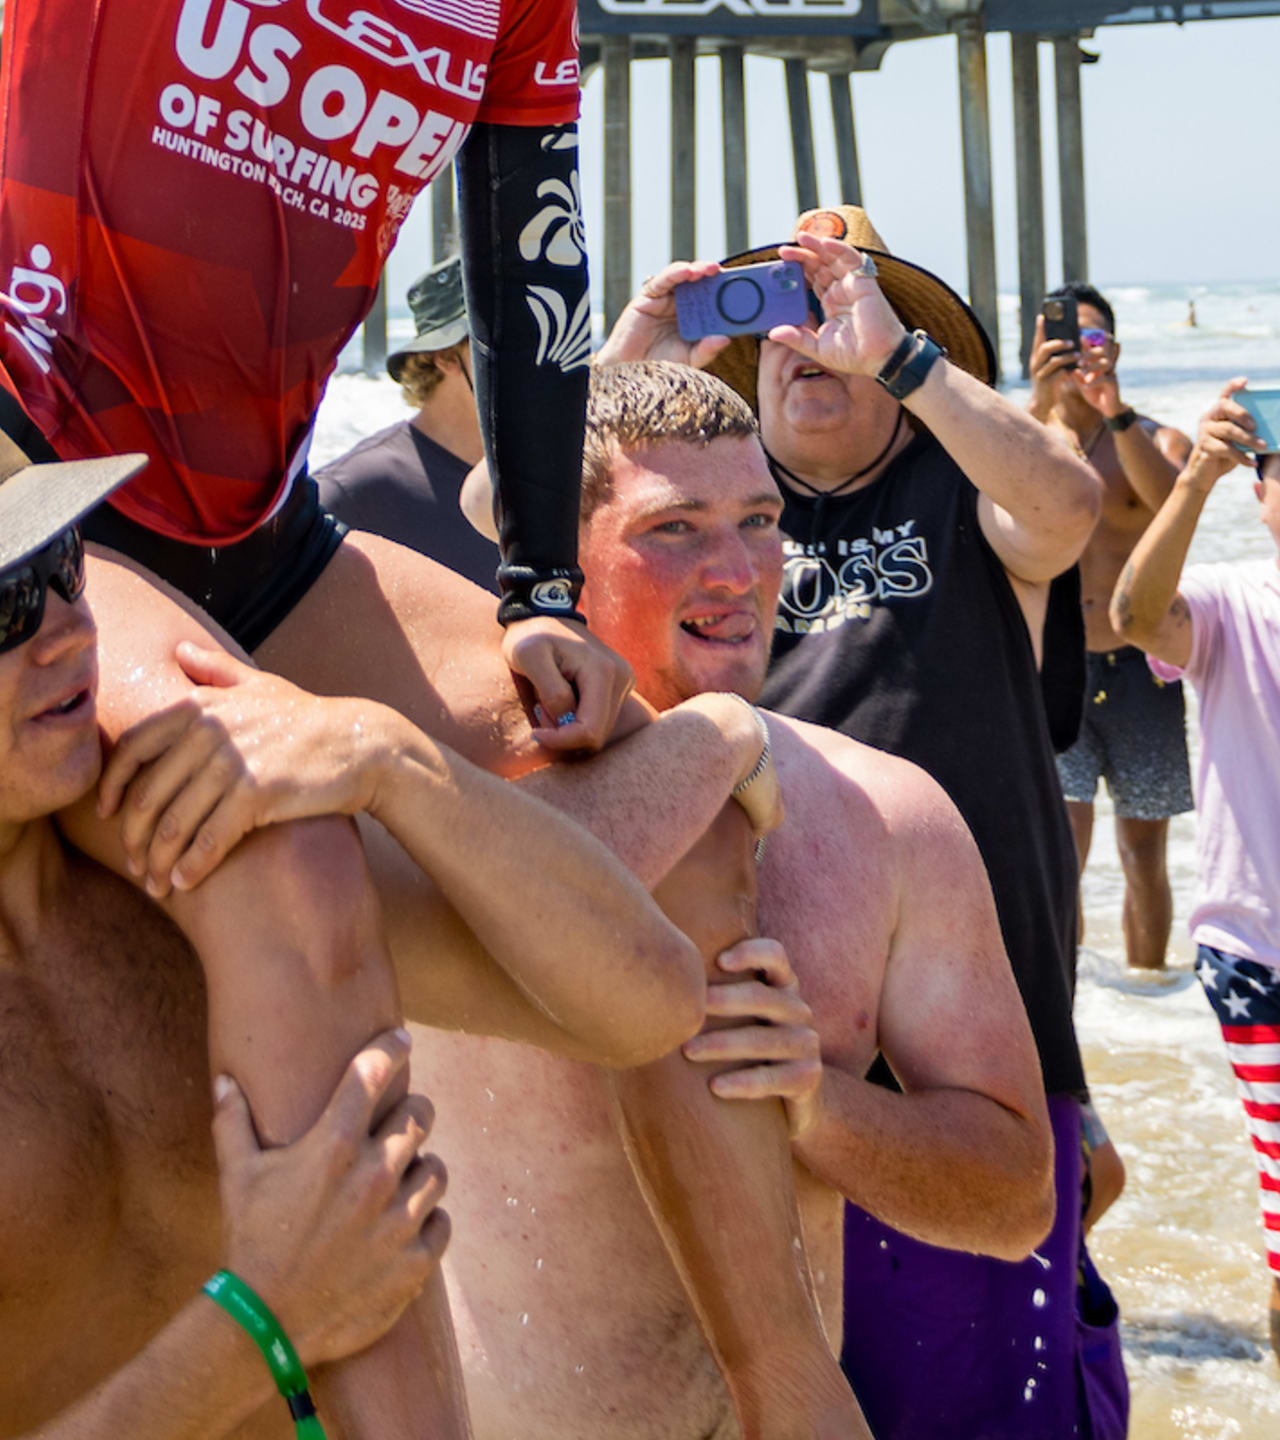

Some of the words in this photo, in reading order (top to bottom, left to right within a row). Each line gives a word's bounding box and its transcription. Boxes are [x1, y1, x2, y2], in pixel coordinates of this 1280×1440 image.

[152, 126, 267, 184] HUNTINGTON
[309, 198, 329, 220] CA
[333, 207, 367, 231] 2025
[158, 83, 219, 136] OF
[224, 111, 380, 210] SURFING
[778, 536, 933, 618] OSS
[873, 520, 916, 545] MY
